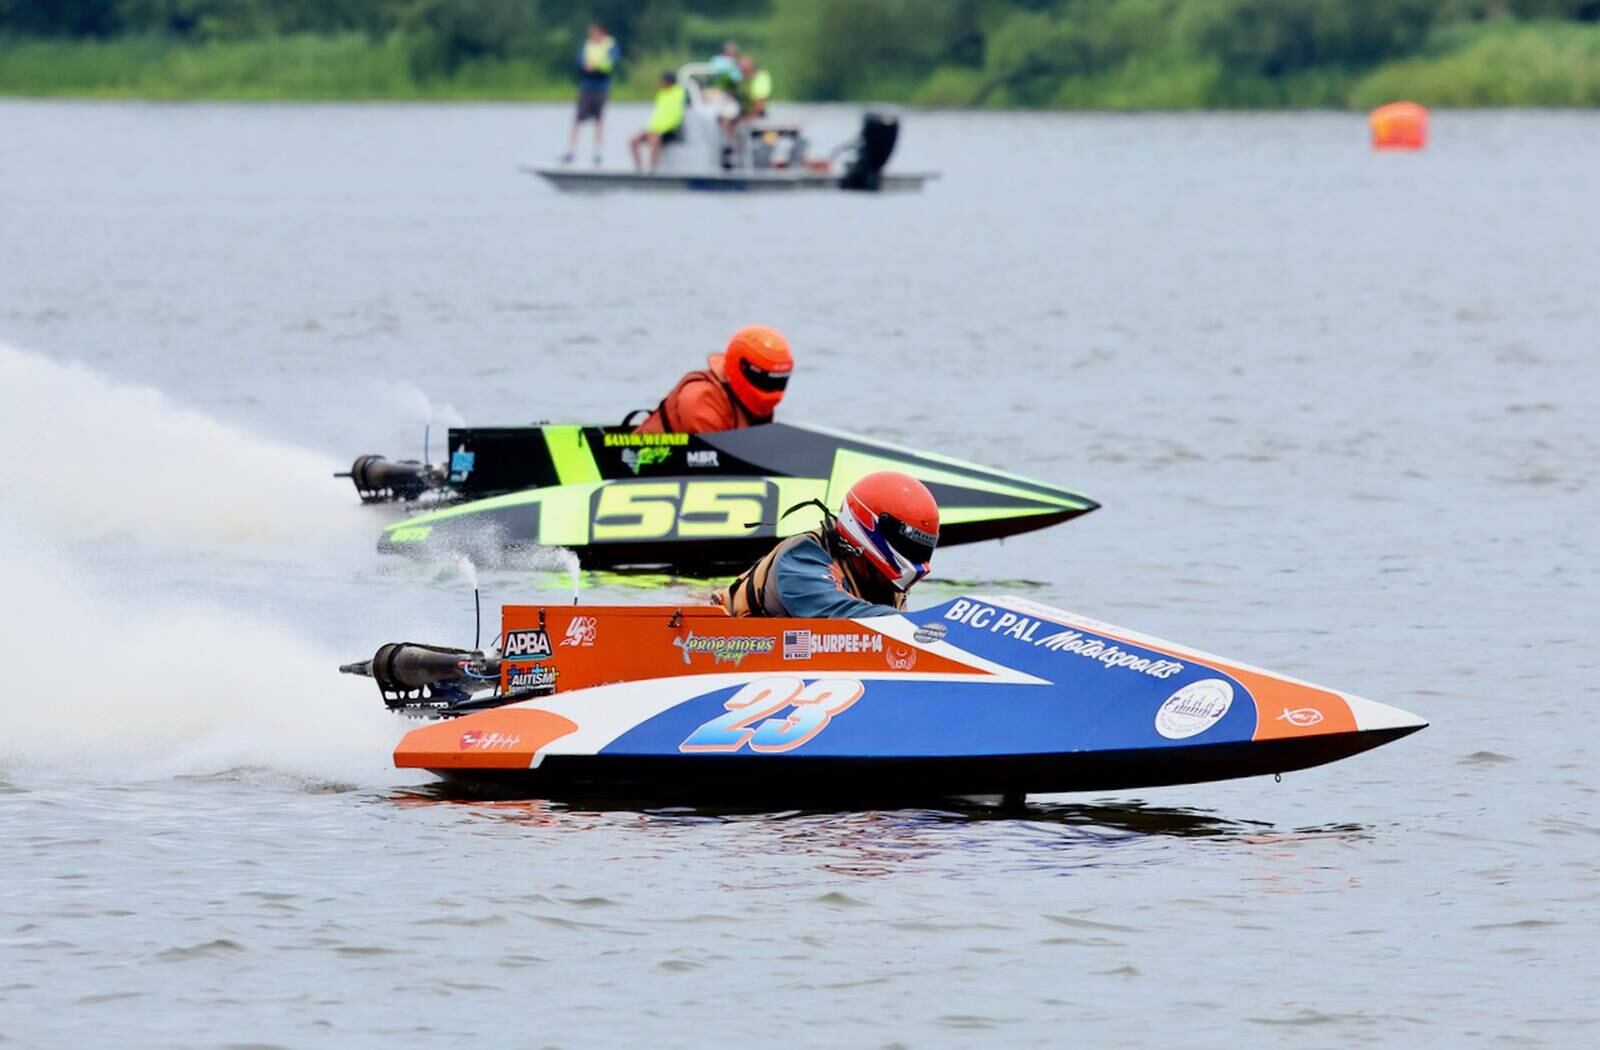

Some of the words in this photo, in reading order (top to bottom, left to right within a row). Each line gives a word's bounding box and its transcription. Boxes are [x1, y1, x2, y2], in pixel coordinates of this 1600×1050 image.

[593, 480, 768, 540] 55
[990, 612, 1042, 643] PAL
[505, 632, 551, 656] APBA
[727, 637, 775, 651] RIDERS
[511, 673, 554, 686] AUTISM
[679, 677, 865, 753] 23
